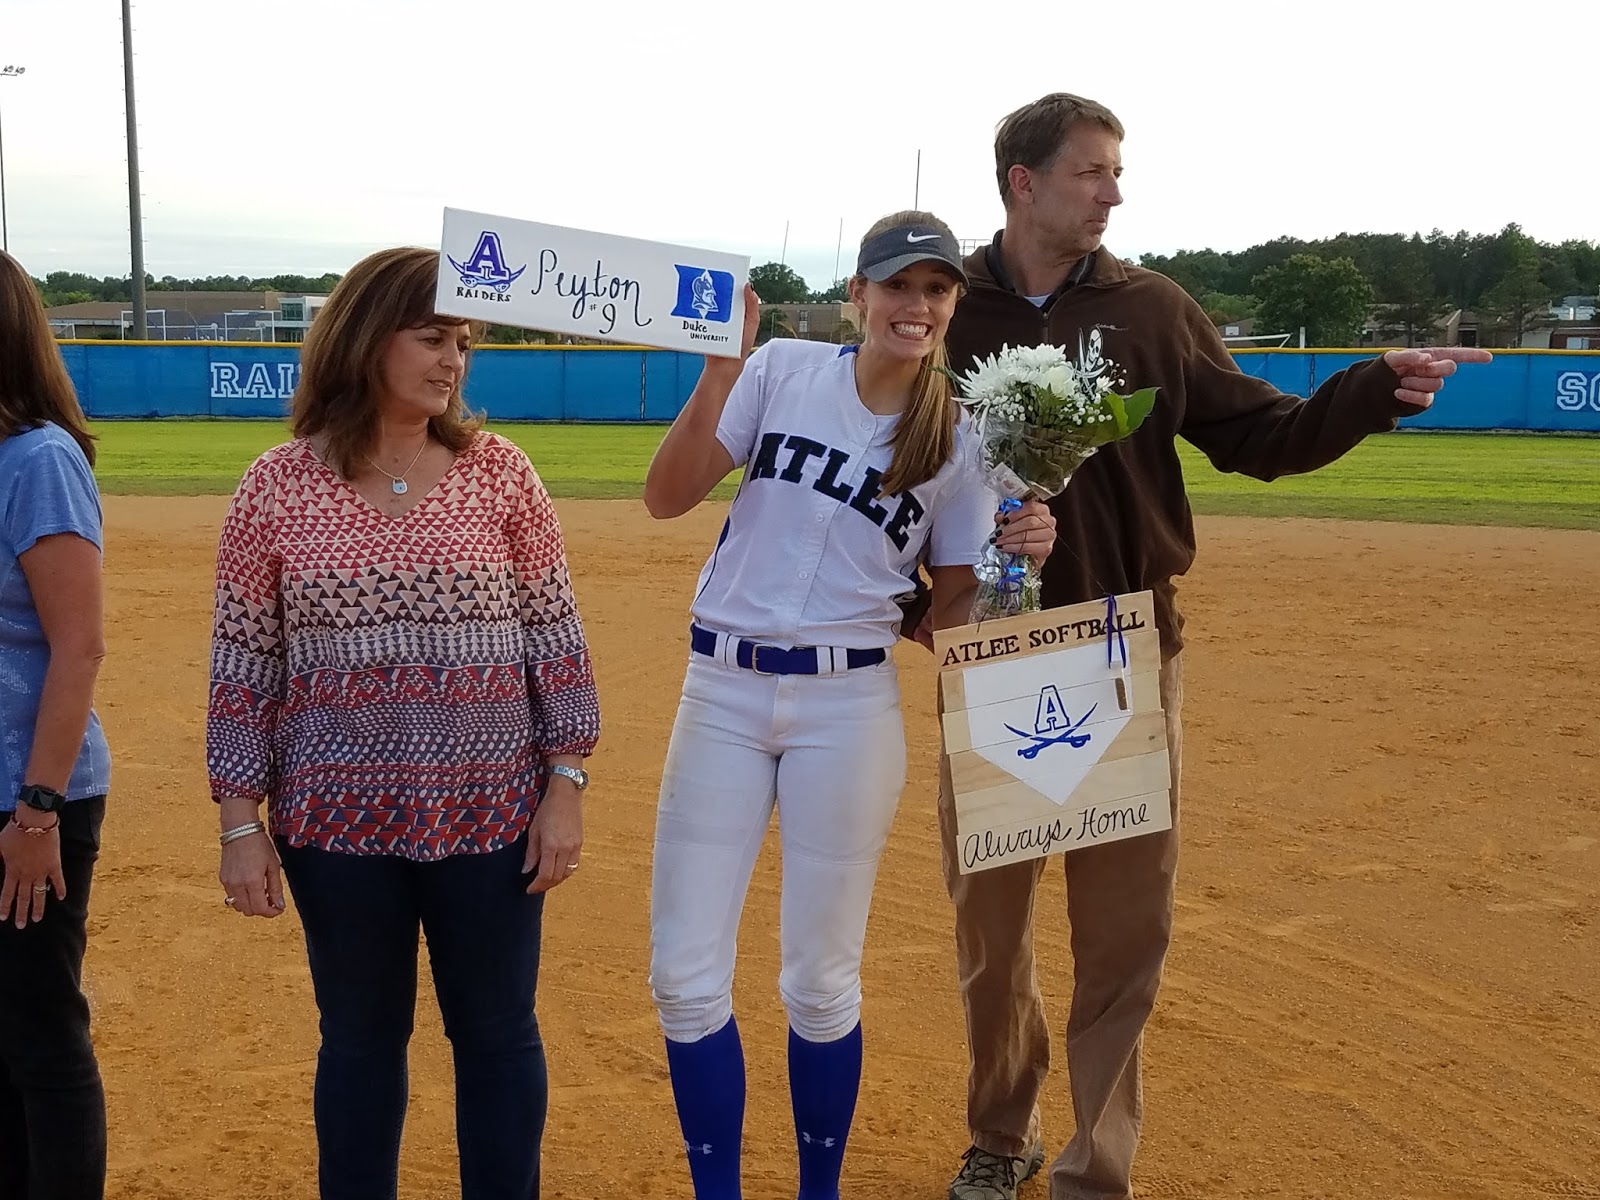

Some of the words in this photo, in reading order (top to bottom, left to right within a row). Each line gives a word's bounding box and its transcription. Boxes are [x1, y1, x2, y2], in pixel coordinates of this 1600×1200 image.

[463, 231, 512, 281] A
[456, 286, 512, 302] RAIDERS
[531, 249, 652, 327] Peyton
[682, 320, 708, 333] Duke
[690, 332, 729, 342] UNIVERSITY
[210, 362, 303, 398] RAI
[750, 432, 925, 553] ATLEE
[941, 635, 1020, 667] ATLEE
[1029, 610, 1145, 649] SOFTBALL
[1034, 685, 1070, 734] A
[963, 818, 1073, 868] Always
[1076, 803, 1150, 841] Home
